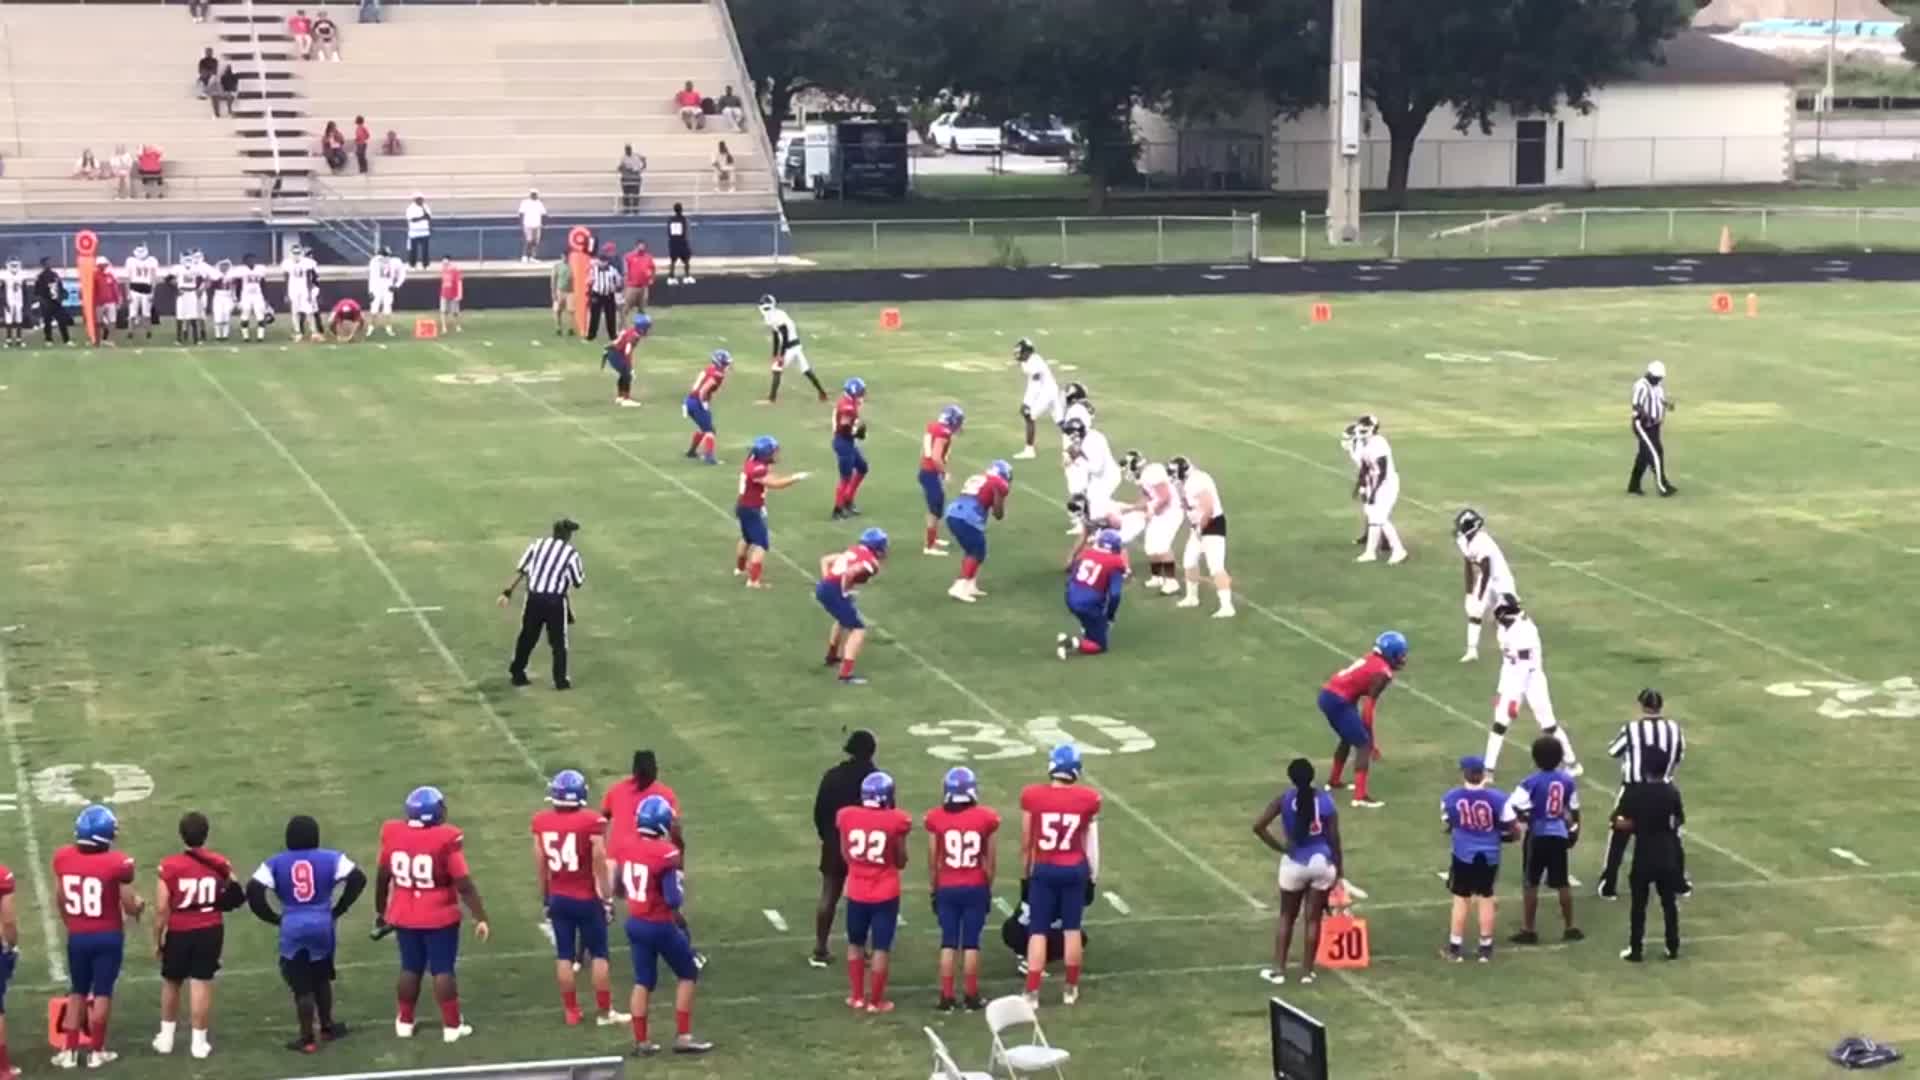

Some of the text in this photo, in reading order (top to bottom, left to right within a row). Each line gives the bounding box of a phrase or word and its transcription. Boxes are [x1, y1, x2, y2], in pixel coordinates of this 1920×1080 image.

[906, 714, 1156, 761] 30
[1457, 799, 1493, 832] 10
[1546, 781, 1565, 818] 8
[848, 829, 887, 864] 22
[944, 830, 981, 868] 92
[1038, 813, 1081, 851] 57
[390, 851, 435, 889] 99
[541, 832, 579, 872] 54
[61, 875, 102, 917] 58
[178, 876, 217, 913] 70
[291, 860, 315, 902] 9
[1327, 926, 1363, 961] 30
